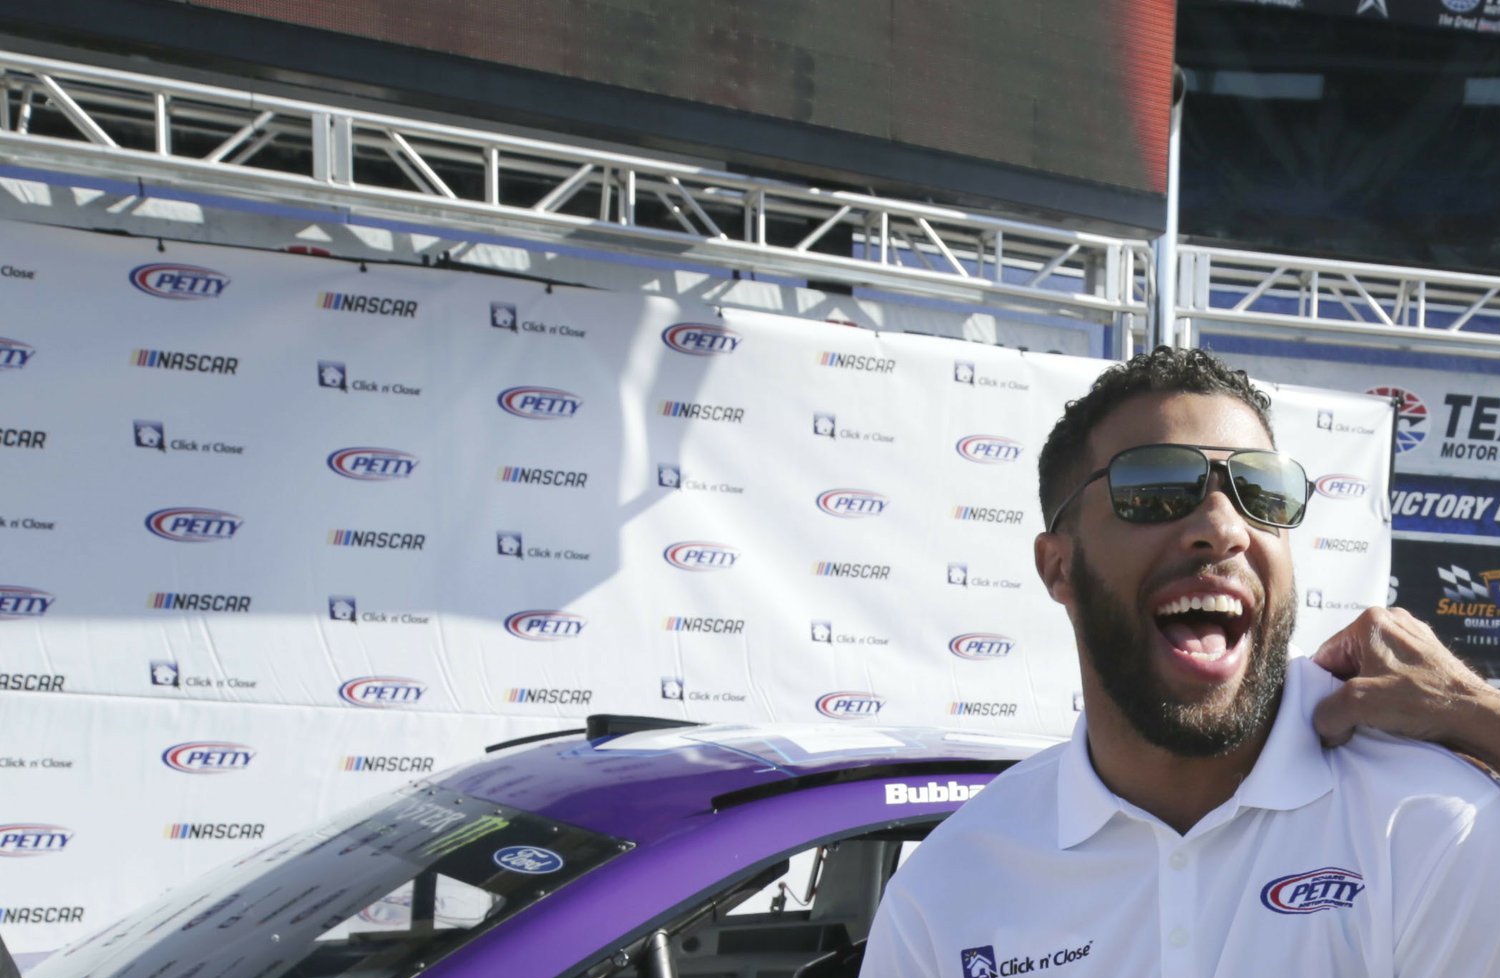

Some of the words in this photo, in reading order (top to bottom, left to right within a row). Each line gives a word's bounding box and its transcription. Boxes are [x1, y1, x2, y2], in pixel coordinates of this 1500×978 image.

[1, 264, 34, 279] Close
[156, 273, 231, 295] PETTY
[342, 296, 418, 318] NASCAR
[522, 321, 545, 333] Click
[562, 325, 585, 338] Close
[683, 332, 741, 351] PETTY
[156, 351, 239, 375] NASCAR
[835, 353, 896, 375] NASCAR
[352, 380, 378, 391] Click
[392, 384, 420, 395] Close
[519, 396, 583, 415] PETTY
[679, 403, 745, 423] NASCAR
[0, 429, 46, 449] CAR
[171, 439, 197, 450] Click
[214, 443, 243, 454] Close
[973, 442, 1024, 459] PETTY
[1440, 442, 1498, 460] MOTOR
[351, 458, 419, 476] PETTY
[518, 468, 588, 488] NASCAR
[1328, 481, 1369, 494] PETTY
[834, 497, 888, 514] PETTY
[22, 518, 54, 530] Close
[968, 507, 1023, 525] NASCAR
[171, 517, 243, 537] PETTY
[351, 532, 425, 550] NASCAR
[528, 548, 552, 557] Click
[564, 551, 589, 560] Close
[684, 550, 739, 565] PETTY
[830, 563, 891, 580] NASCAR
[0, 597, 55, 615] ETTY
[173, 593, 252, 612] NASCAR
[1437, 598, 1496, 617] SALUTE
[362, 613, 387, 621] Click
[402, 615, 428, 623] Close
[681, 618, 744, 634] NASCAR
[524, 619, 586, 635] PETTY
[965, 641, 1014, 654] PETTY
[0, 674, 65, 691] ASCAR
[186, 677, 212, 685] Click
[228, 680, 256, 688] Close
[362, 685, 427, 699] PETTY
[525, 689, 592, 704] NASCAR
[834, 700, 885, 713] PETTY
[962, 702, 1017, 717] NASCAR
[187, 751, 256, 766] PETTY
[361, 756, 434, 772] NASCAR
[0, 832, 75, 848] PETTY
[188, 824, 265, 840] NASCAR
[501, 849, 552, 870] Ford
[1288, 881, 1365, 903] PETTY
[3, 907, 84, 923] NASCAR
[1000, 958, 1034, 978] Click
[1053, 944, 1090, 967] Close
